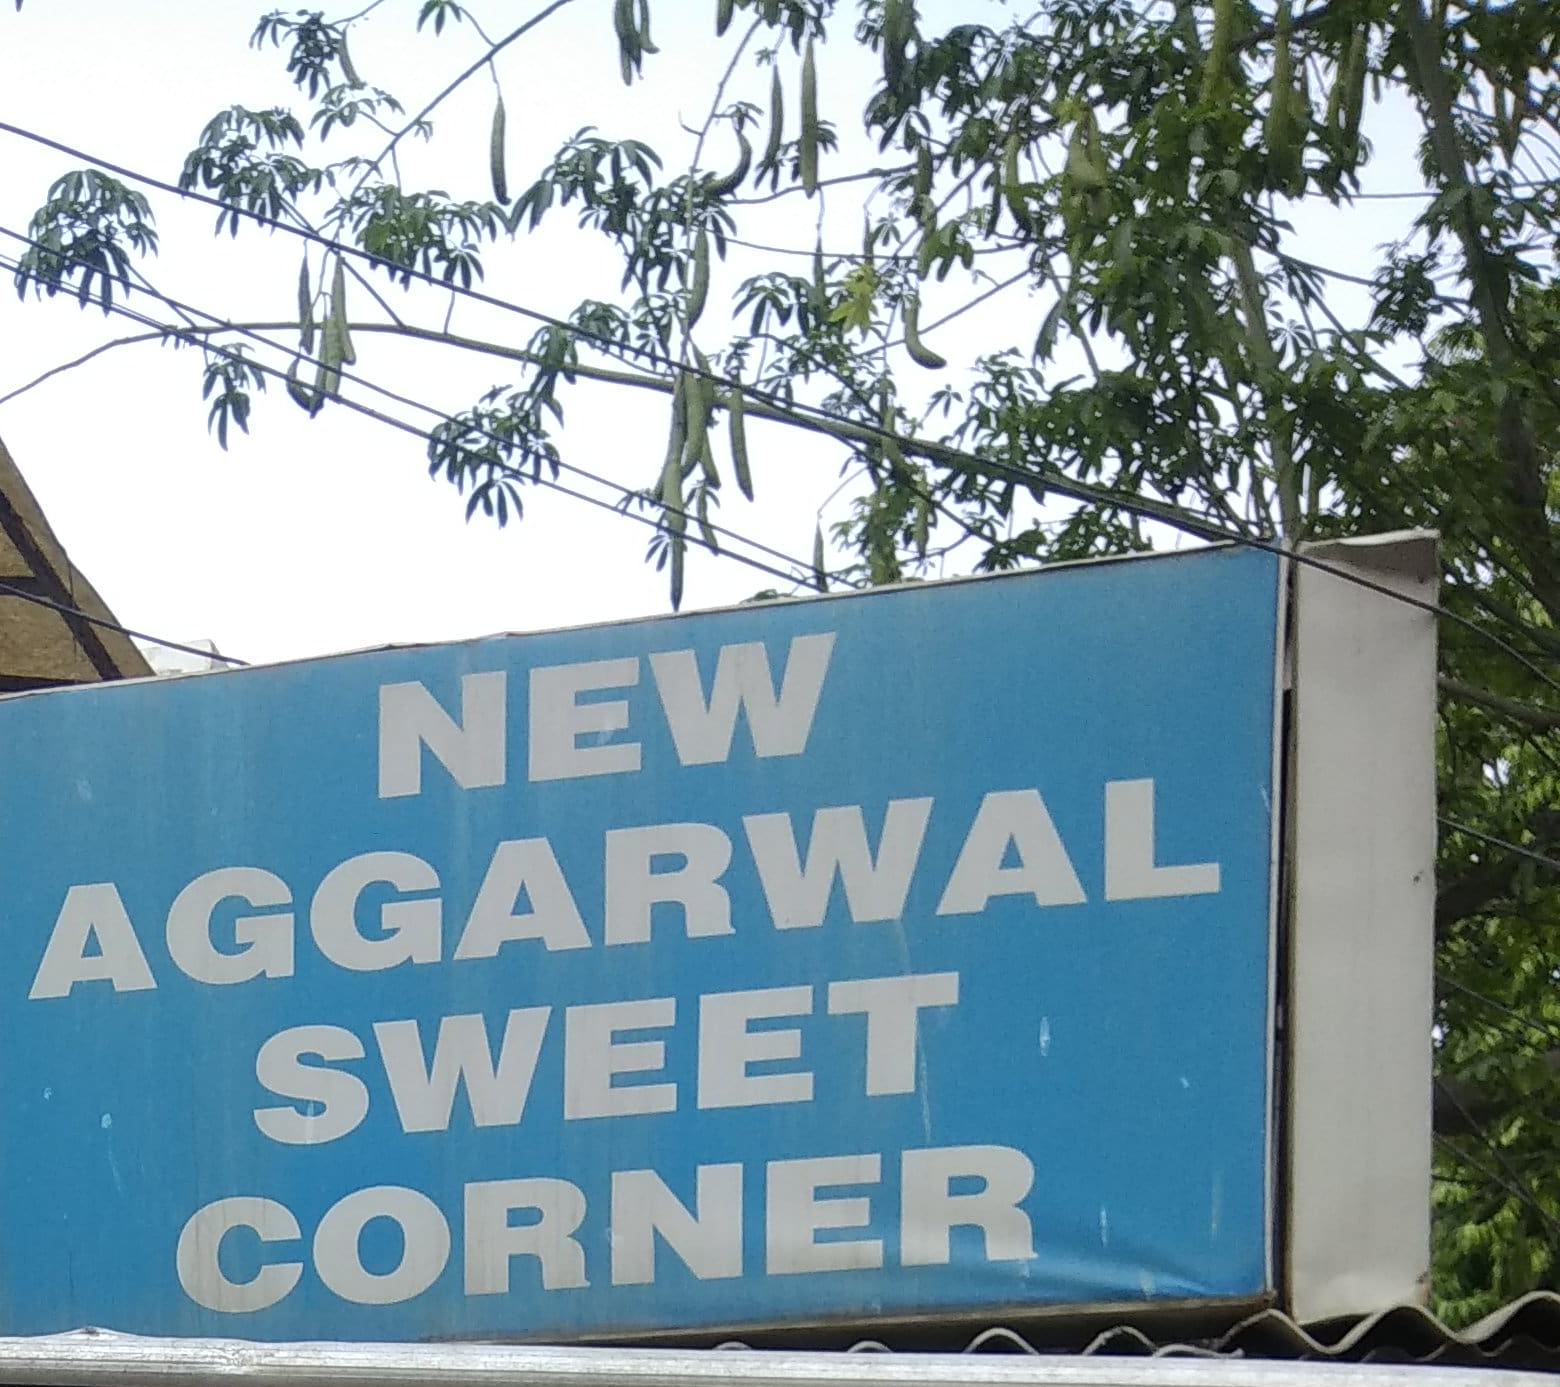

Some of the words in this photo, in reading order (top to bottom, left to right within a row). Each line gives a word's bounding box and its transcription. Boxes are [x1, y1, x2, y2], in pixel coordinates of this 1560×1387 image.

[377, 631, 838, 799] NEW
[27, 776, 1222, 1000] AGGARWAL
[253, 971, 959, 1146] SWEET
[175, 1144, 1038, 1314] CORNER
